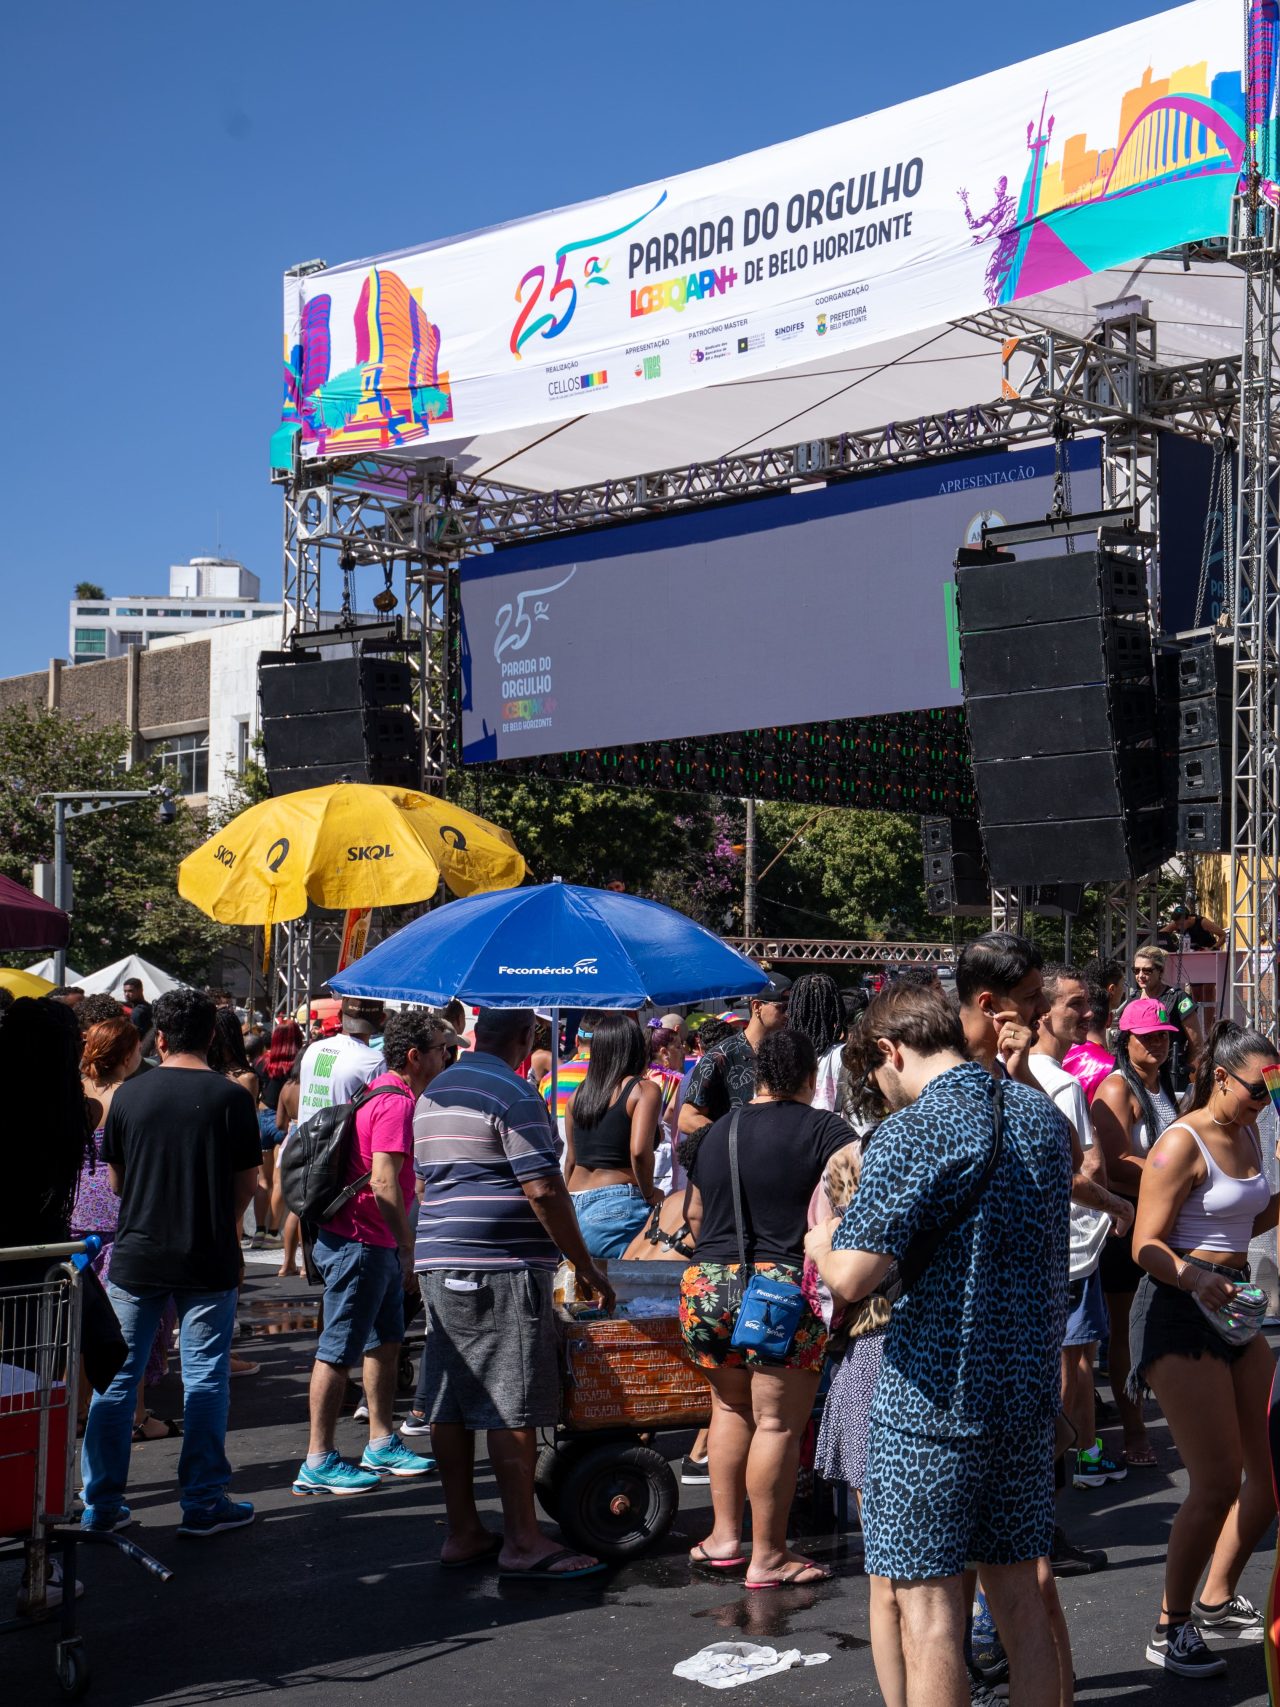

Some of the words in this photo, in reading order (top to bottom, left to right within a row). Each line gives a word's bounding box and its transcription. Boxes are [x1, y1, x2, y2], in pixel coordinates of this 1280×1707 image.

[629, 216, 734, 279] PARADA
[743, 202, 780, 247] DO
[786, 157, 924, 234] ORGULHO
[630, 265, 738, 319] LGBTQIAPN+
[744, 257, 764, 285] DE
[768, 244, 808, 278] BELO
[813, 211, 913, 265] HORIZONTE
[815, 284, 870, 306] COORGANIZAÇÃO
[829, 305, 868, 323] PREFEITURA
[688, 325, 723, 340] PATROCÍNIO
[724, 319, 748, 330] MASTER
[774, 321, 805, 336] SINDIFES
[625, 339, 670, 355] APRESENTAÇÃO
[545, 361, 579, 374] REALIZAÇÃO
[548, 376, 581, 396] CELLOS
[938, 466, 1035, 494] APRESENTAÇÃO
[501, 658, 536, 677] PARADA
[539, 656, 551, 671] DO
[501, 675, 552, 699] ORGULHO
[213, 844, 237, 869] SKOL
[347, 844, 394, 862] SKOL
[498, 966, 574, 975] Fecomércio
[575, 965, 598, 975] MG
